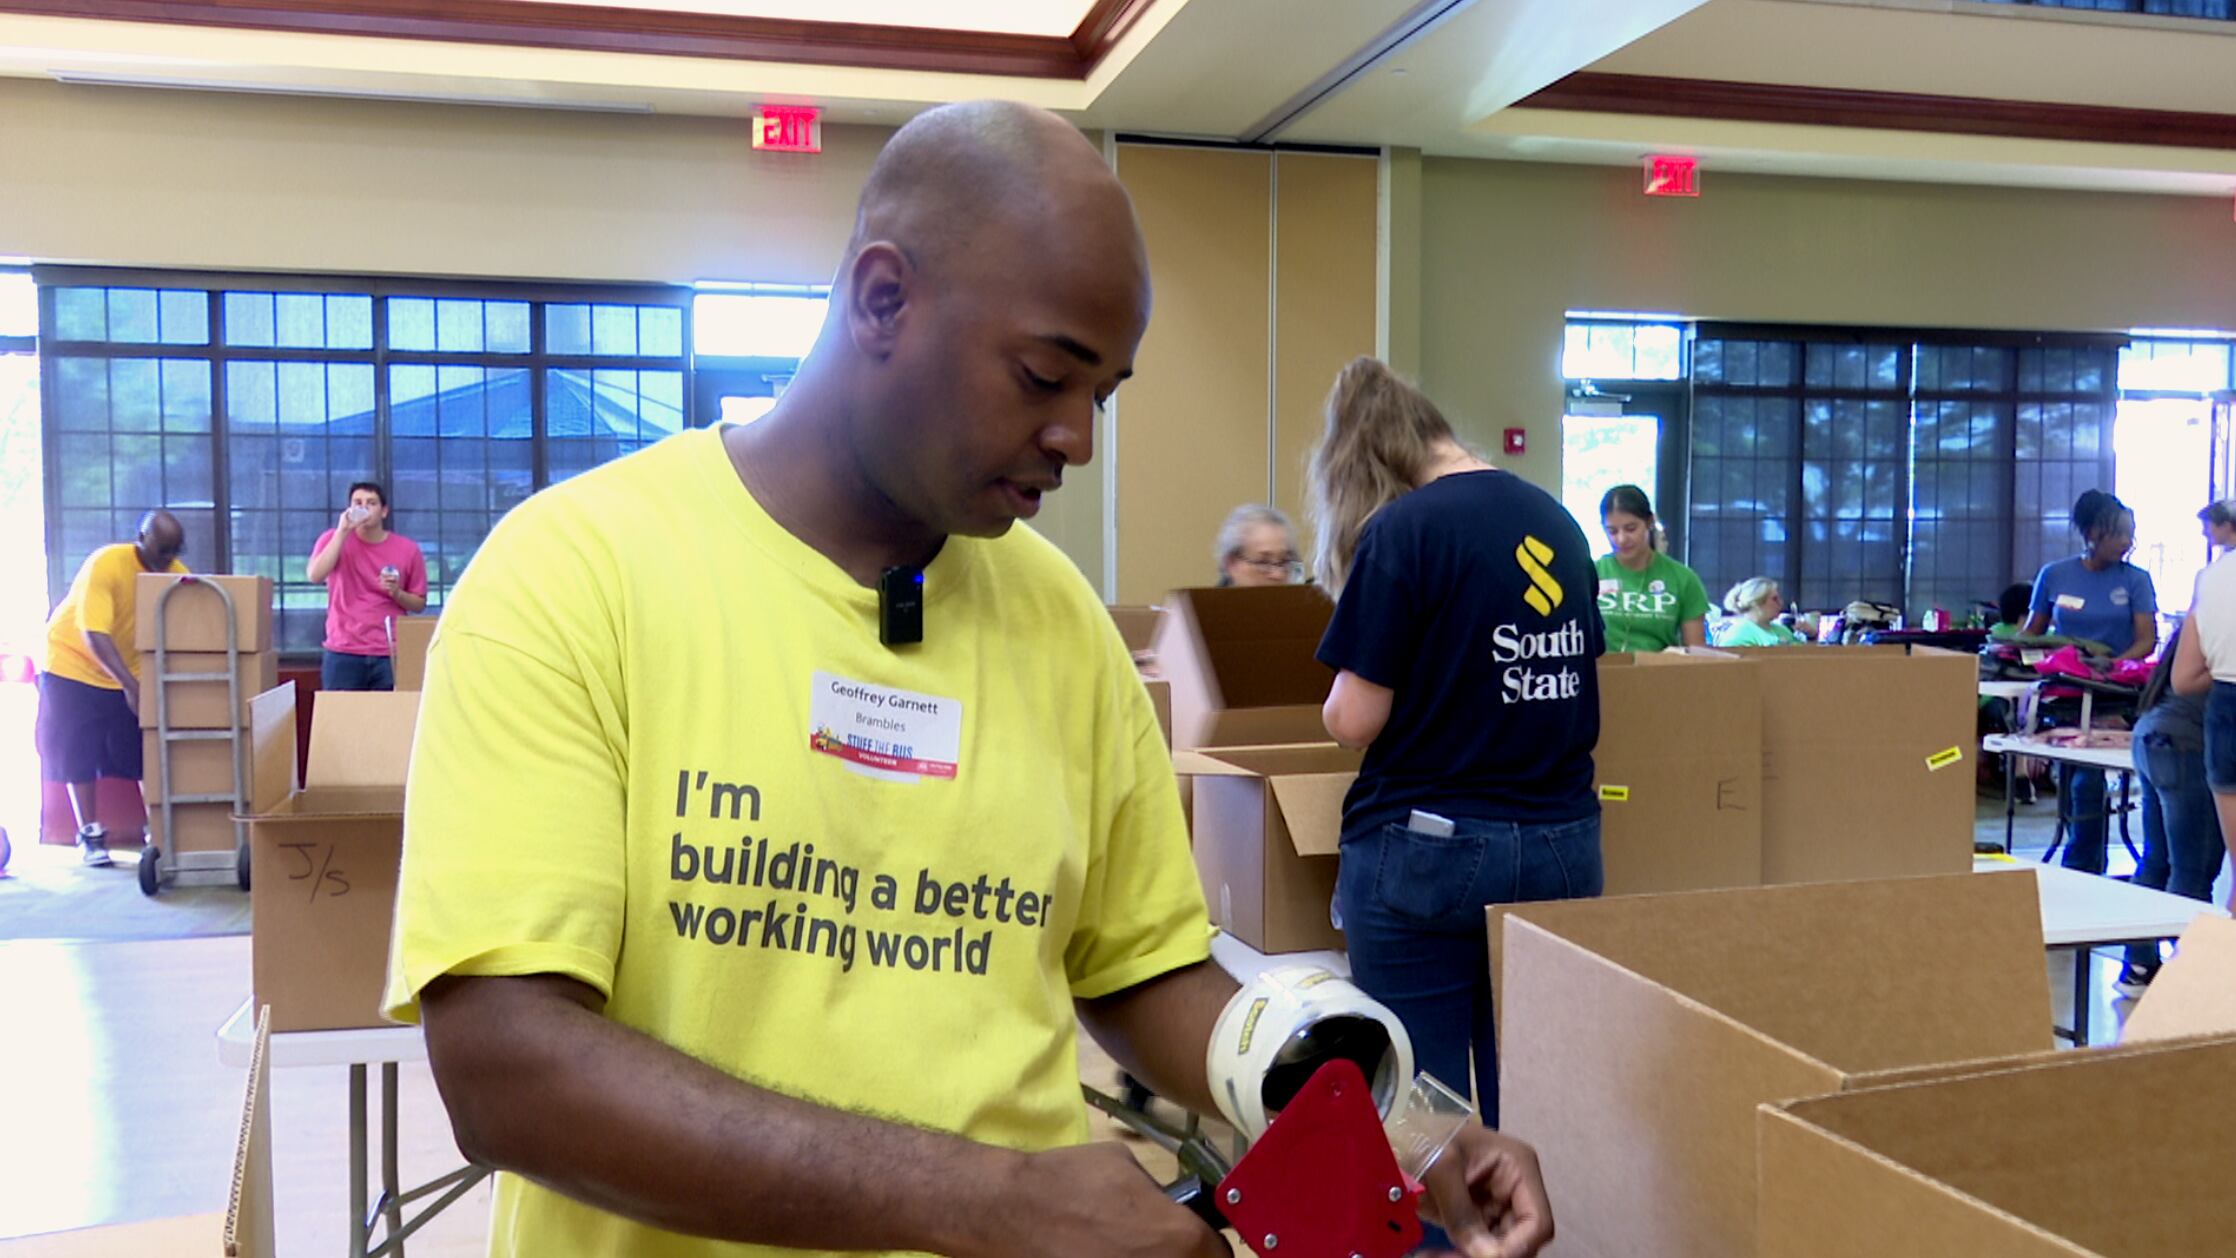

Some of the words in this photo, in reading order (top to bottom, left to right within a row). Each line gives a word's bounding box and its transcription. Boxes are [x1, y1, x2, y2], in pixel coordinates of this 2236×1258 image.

[763, 111, 816, 146] EXIT
[1654, 159, 1695, 193] EXIT
[1597, 591, 1677, 612] SRP
[1492, 618, 1585, 662] South
[831, 681, 885, 708] Geoffrey
[888, 695, 938, 715] Garnett
[1501, 665, 1581, 704] State
[856, 712, 907, 732] Brambles
[847, 733, 873, 753] STUFF
[893, 744, 913, 760] BUS
[676, 769, 762, 821] I'm
[1717, 776, 1747, 811] E
[671, 832, 859, 914] building
[870, 873, 898, 911] a
[914, 868, 1053, 928] better
[669, 900, 857, 973] working
[866, 927, 993, 975] world
